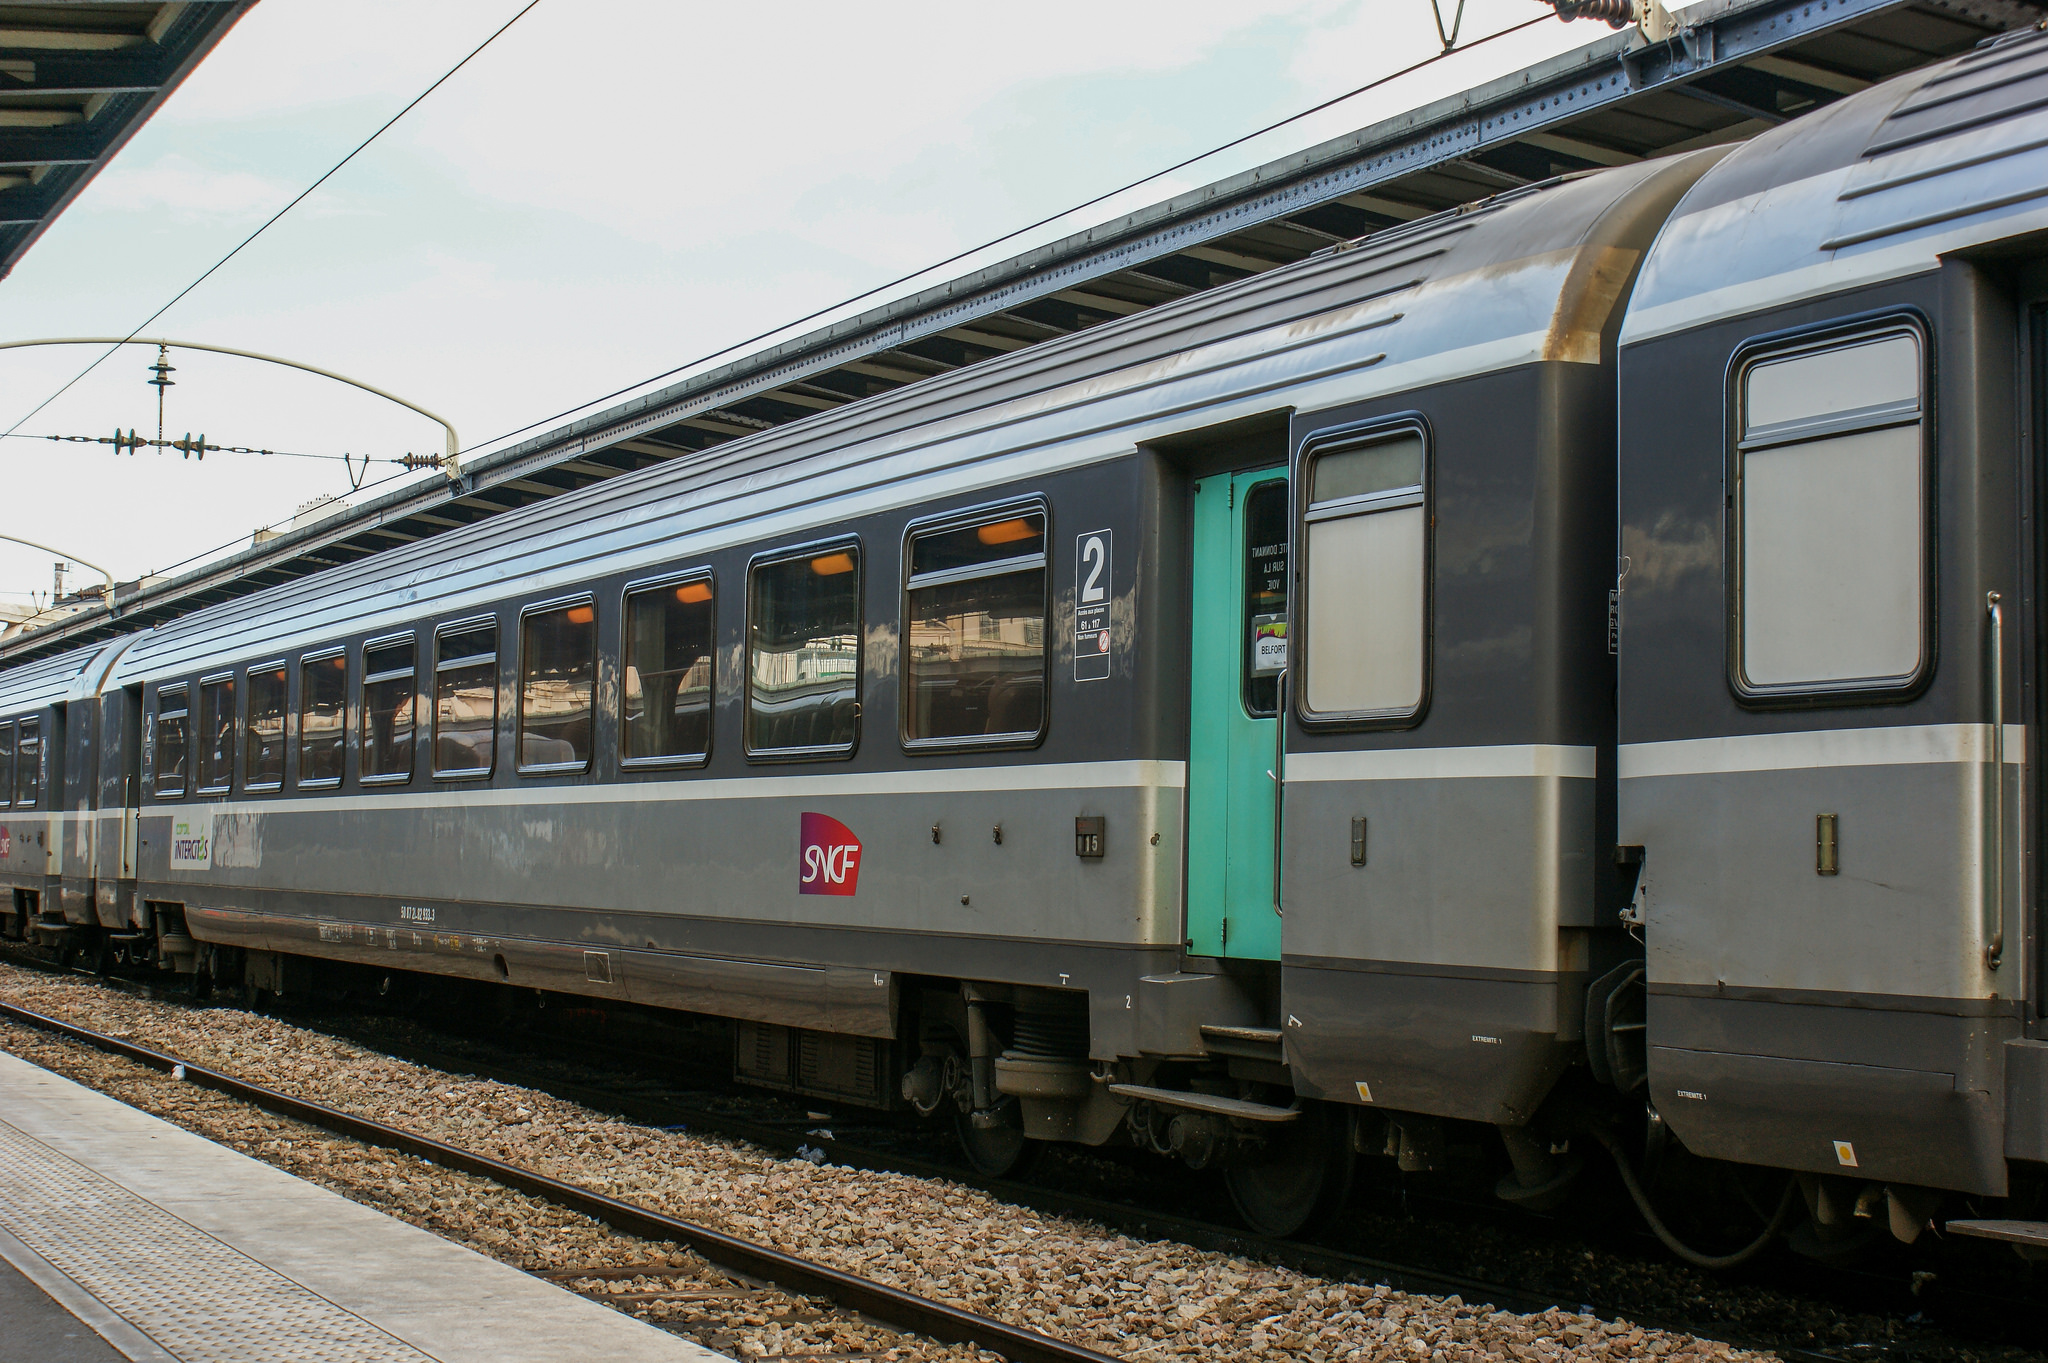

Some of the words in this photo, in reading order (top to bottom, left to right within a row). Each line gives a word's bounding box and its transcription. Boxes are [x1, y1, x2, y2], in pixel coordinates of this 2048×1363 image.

[1082, 536, 1105, 602] 2
[1080, 620, 1087, 631] 61
[1092, 618, 1101, 629] 117
[1261, 644, 1286, 655] BELFORT
[147, 714, 152, 742] 2
[1085, 835, 1098, 852] 15
[802, 845, 859, 884] SNCF
[1126, 995, 1131, 1009] 2
